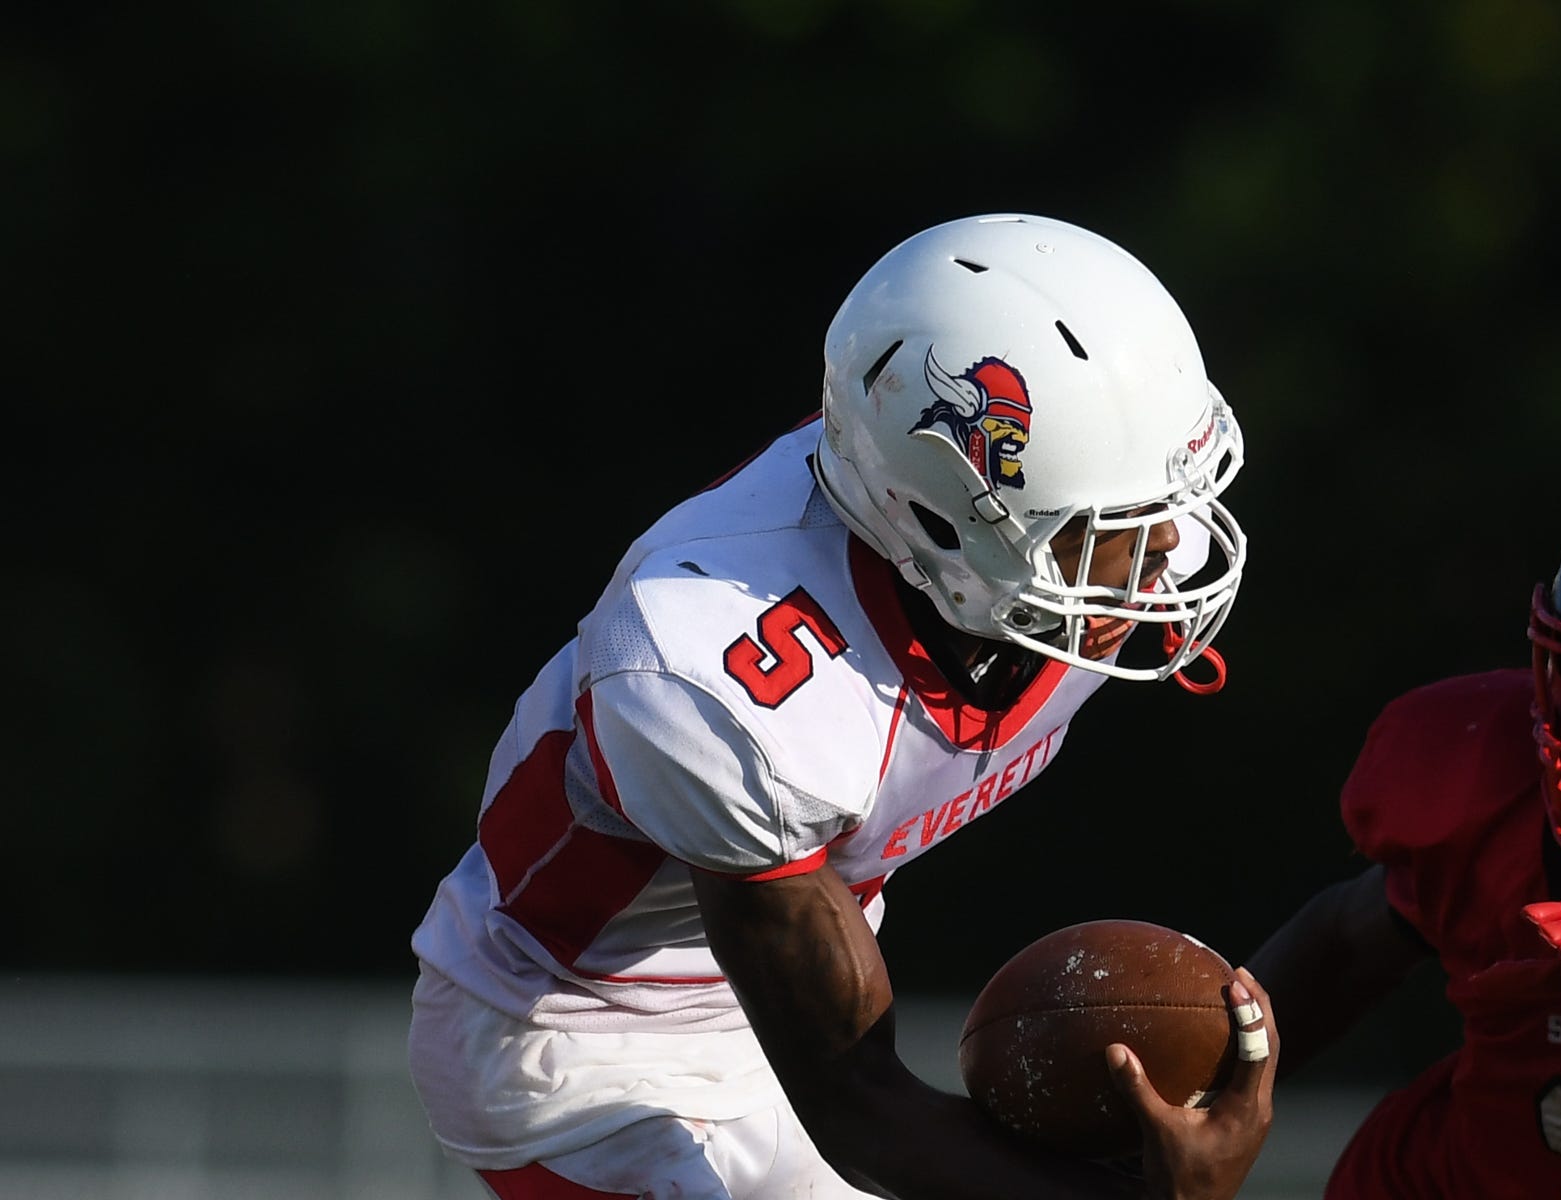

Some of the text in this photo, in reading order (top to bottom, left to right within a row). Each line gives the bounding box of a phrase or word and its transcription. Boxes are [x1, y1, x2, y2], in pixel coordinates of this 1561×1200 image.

[1029, 509, 1060, 517] Riddell
[723, 586, 848, 710] 5
[881, 725, 1066, 860] EVERETT
